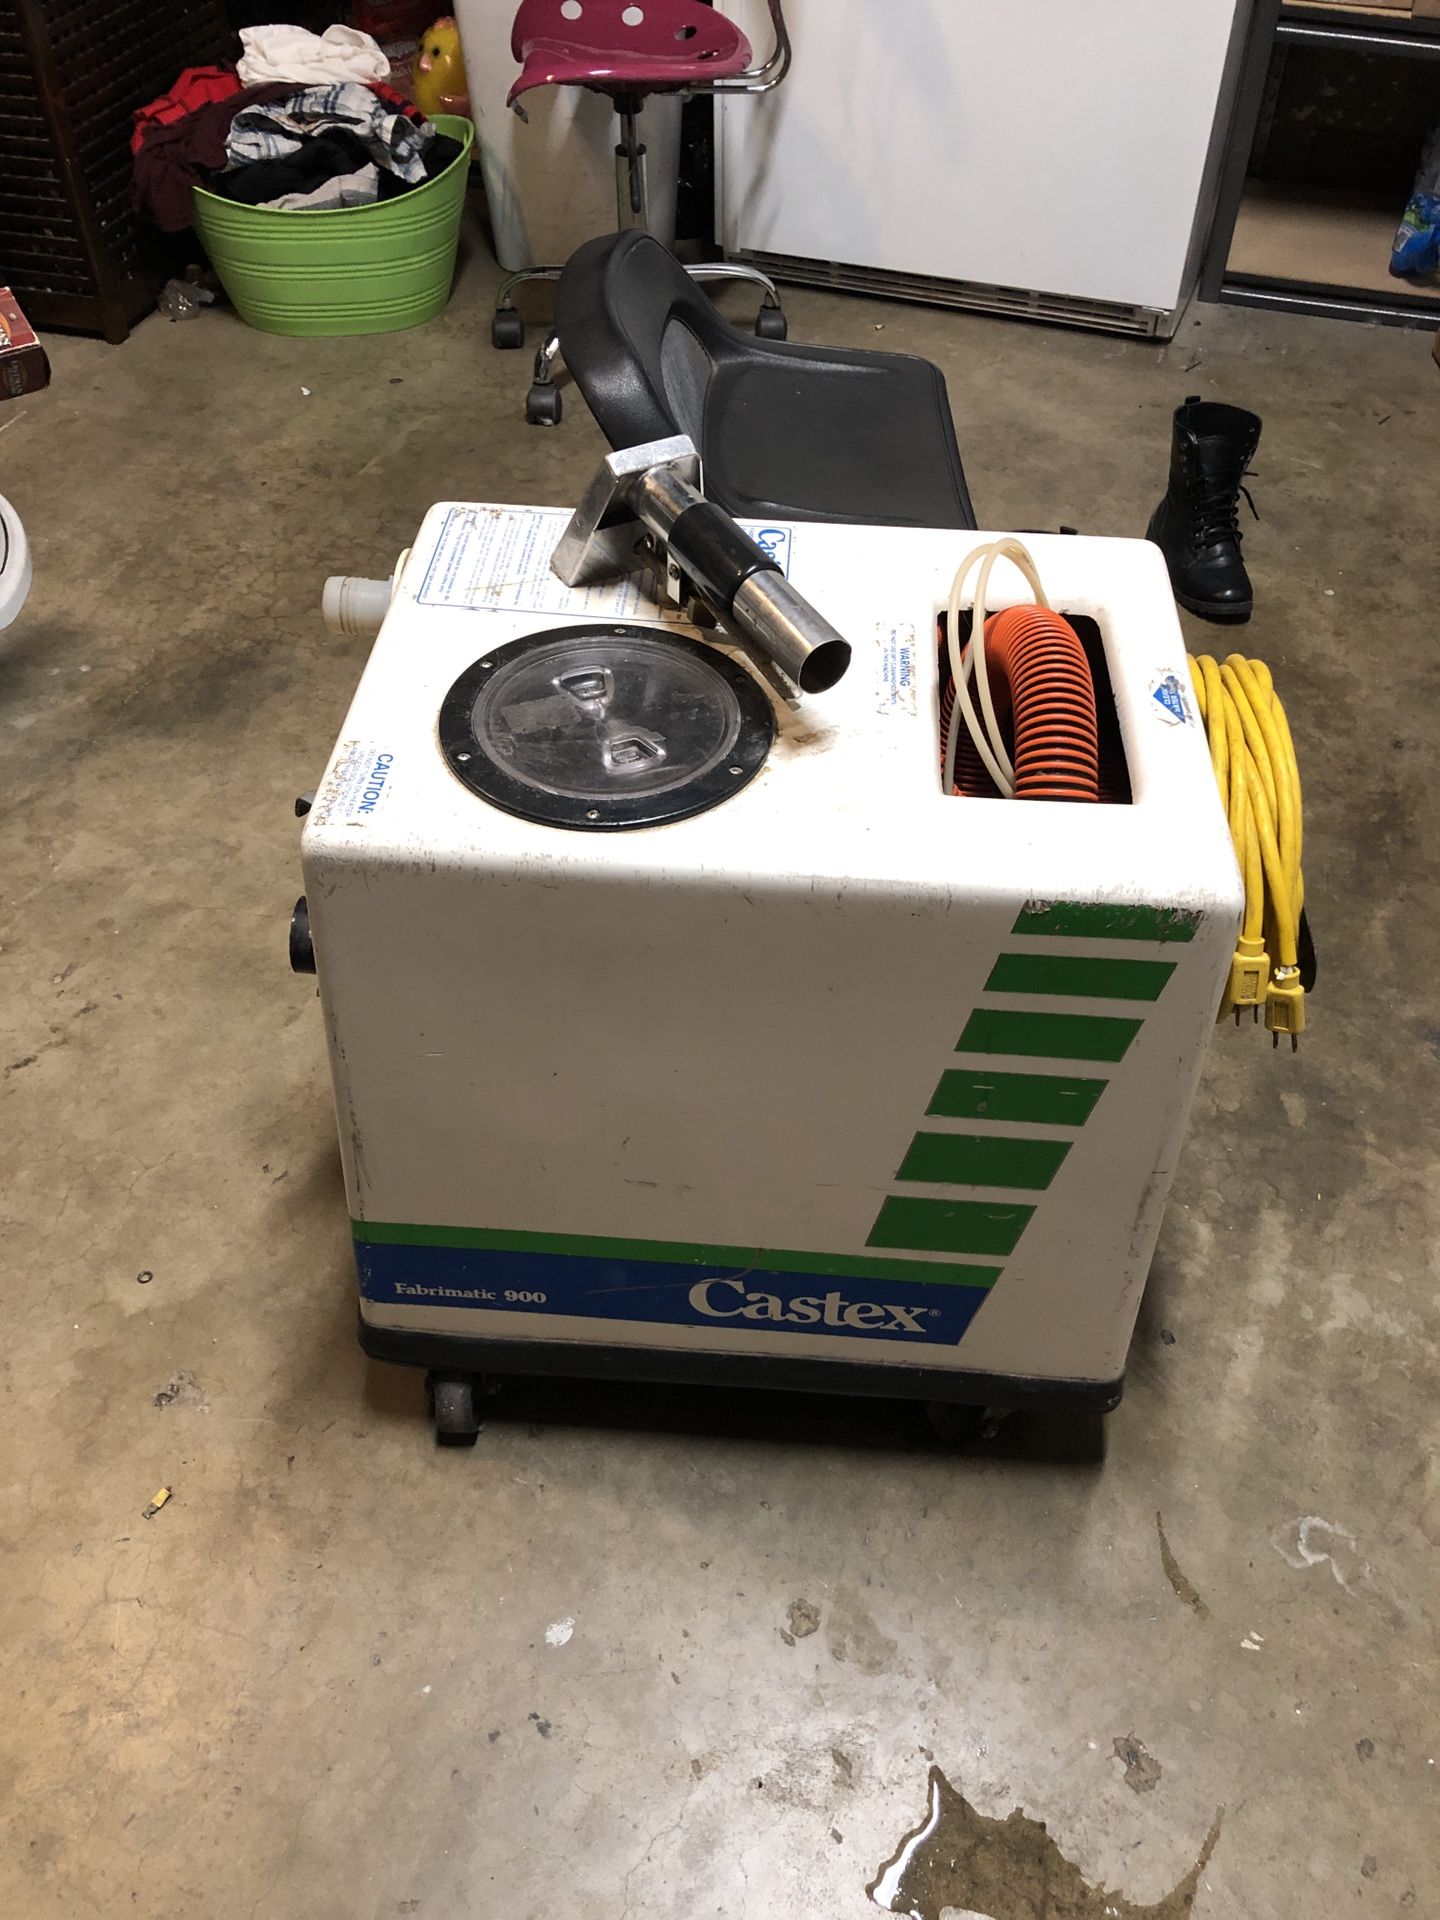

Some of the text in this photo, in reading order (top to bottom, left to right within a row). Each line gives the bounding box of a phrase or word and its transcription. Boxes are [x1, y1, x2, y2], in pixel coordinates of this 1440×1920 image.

[900, 647, 910, 687] WARNING
[357, 753, 394, 814] CAUTION:
[393, 1282, 548, 1305] Fabrimatic 900
